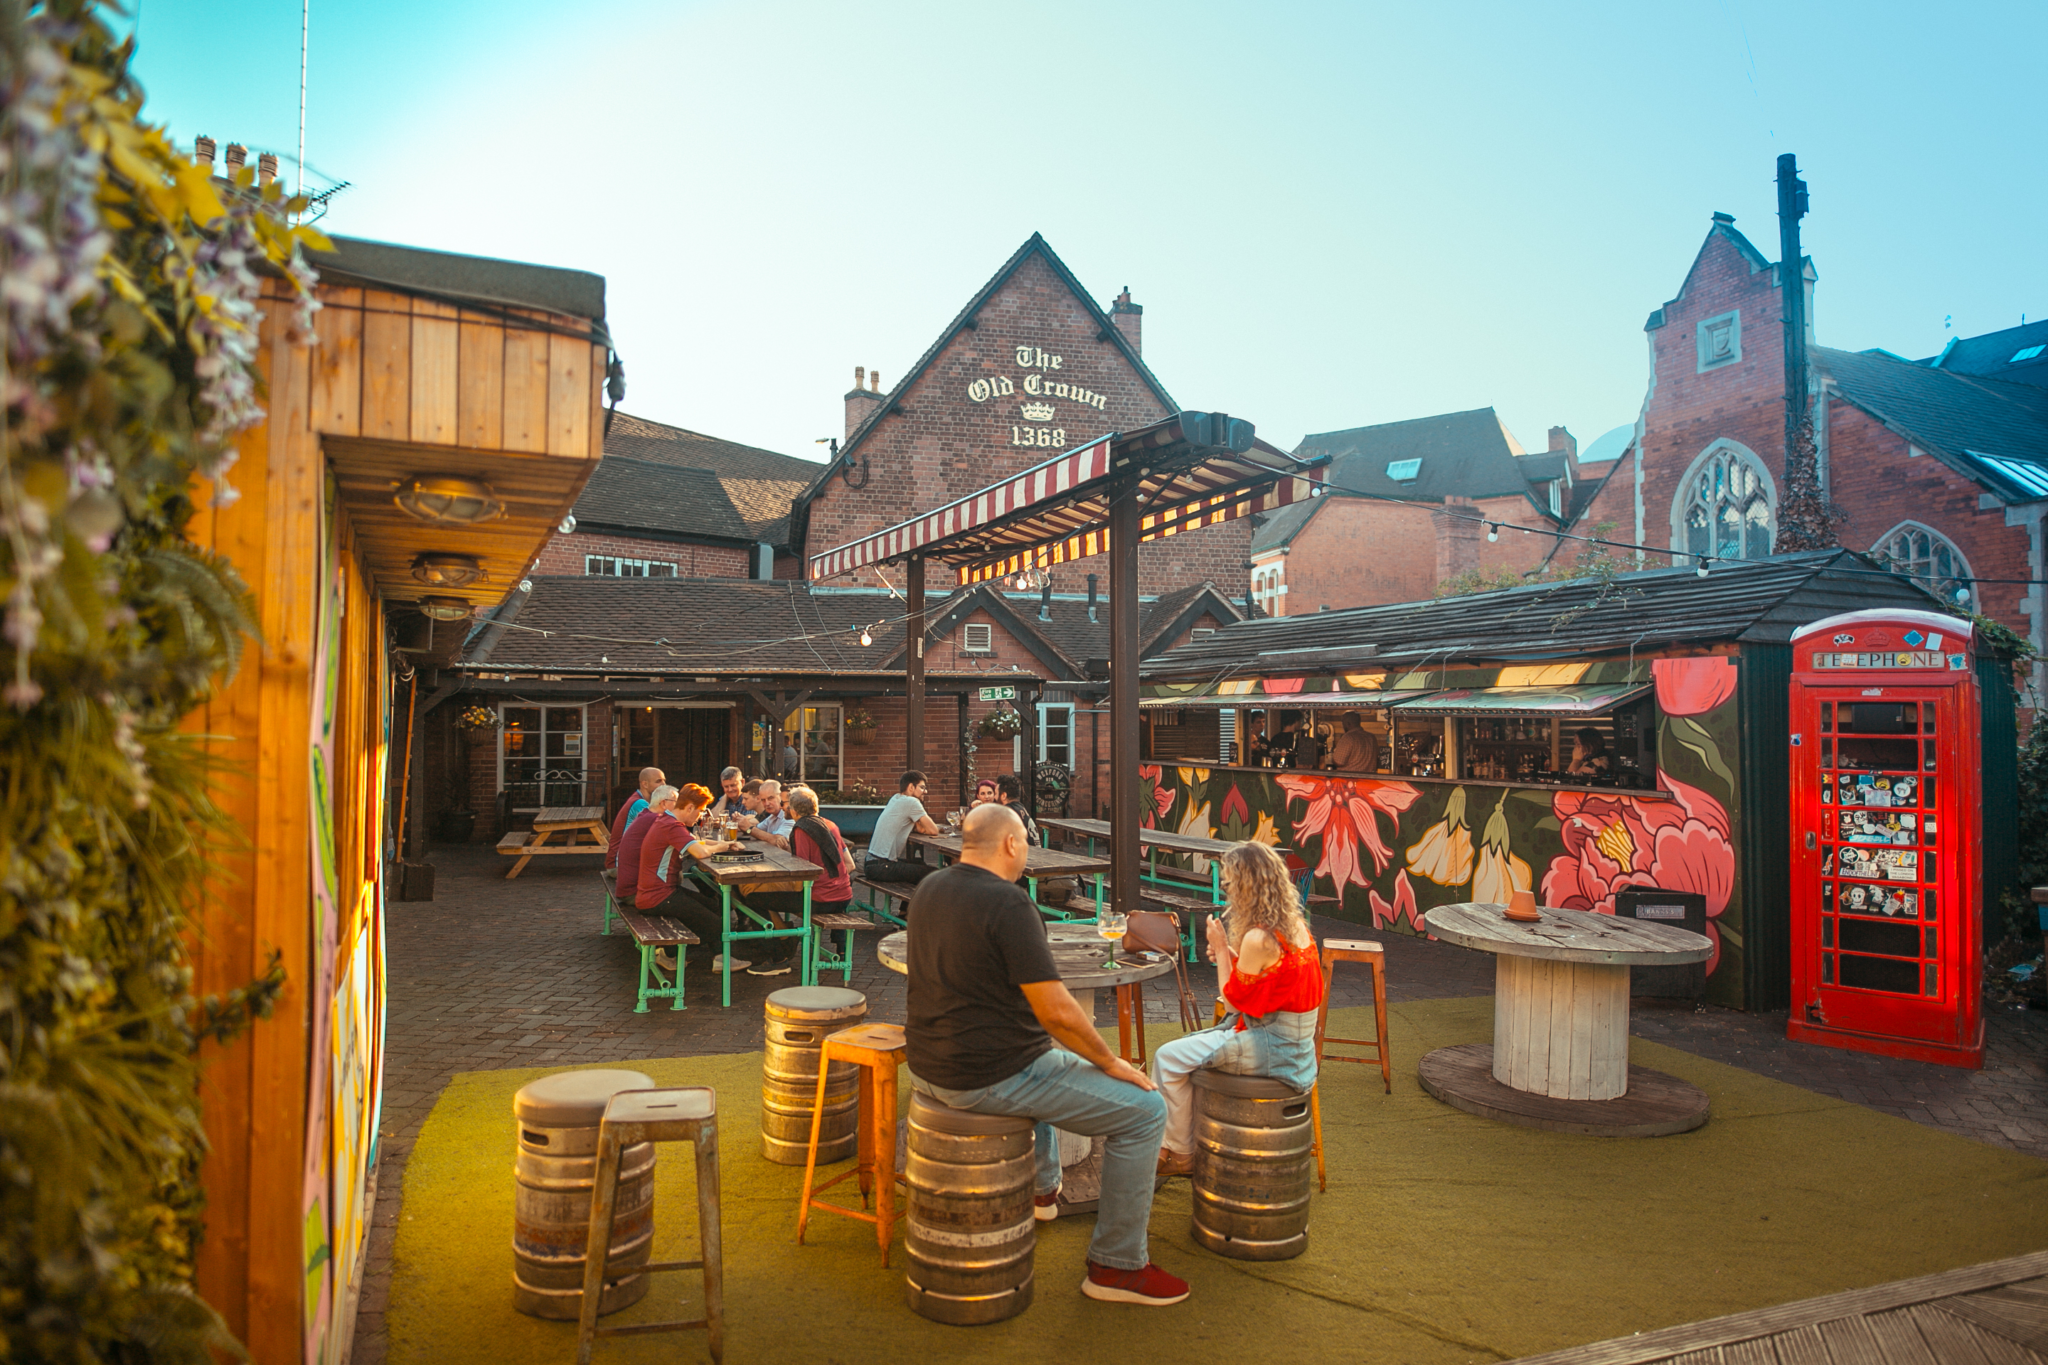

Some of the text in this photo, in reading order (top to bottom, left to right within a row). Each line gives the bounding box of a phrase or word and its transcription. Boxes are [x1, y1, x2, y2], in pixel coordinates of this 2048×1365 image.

[1015, 345, 1063, 373] The
[967, 374, 1108, 411] Old Crown
[1011, 426, 1066, 448] 1368
[1817, 652, 1940, 667] TEEPHNE
